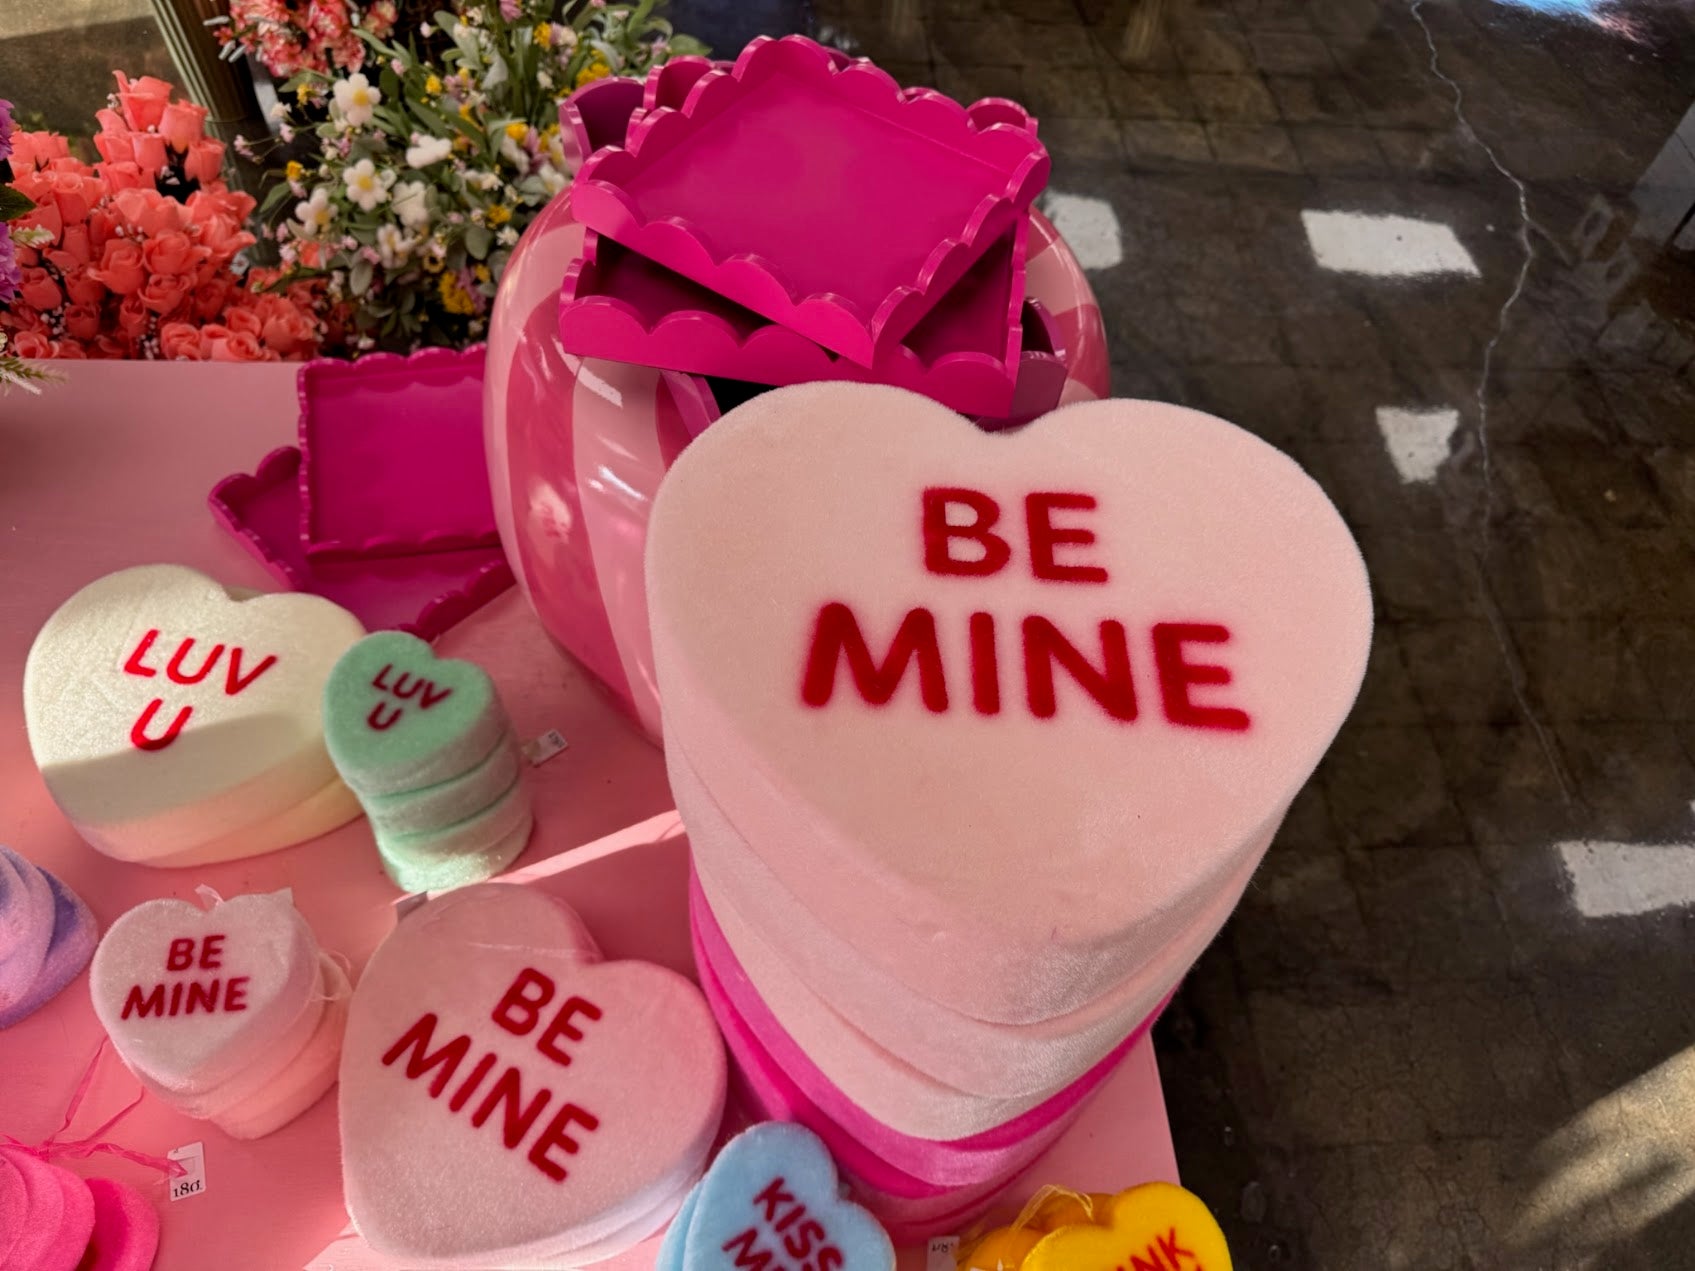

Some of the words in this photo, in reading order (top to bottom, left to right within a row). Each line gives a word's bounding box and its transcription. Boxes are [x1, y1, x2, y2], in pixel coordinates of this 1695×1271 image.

[922, 487, 1109, 584] BE
[124, 629, 277, 696] LUV
[371, 663, 453, 711] LUV
[800, 602, 1251, 732] MINE
[130, 698, 193, 752] U
[367, 702, 404, 731] U
[166, 934, 226, 972] BE
[121, 976, 250, 1020] MINE
[491, 967, 603, 1067] BE
[382, 1012, 599, 1183] MINE
[721, 1227, 786, 1271] M
